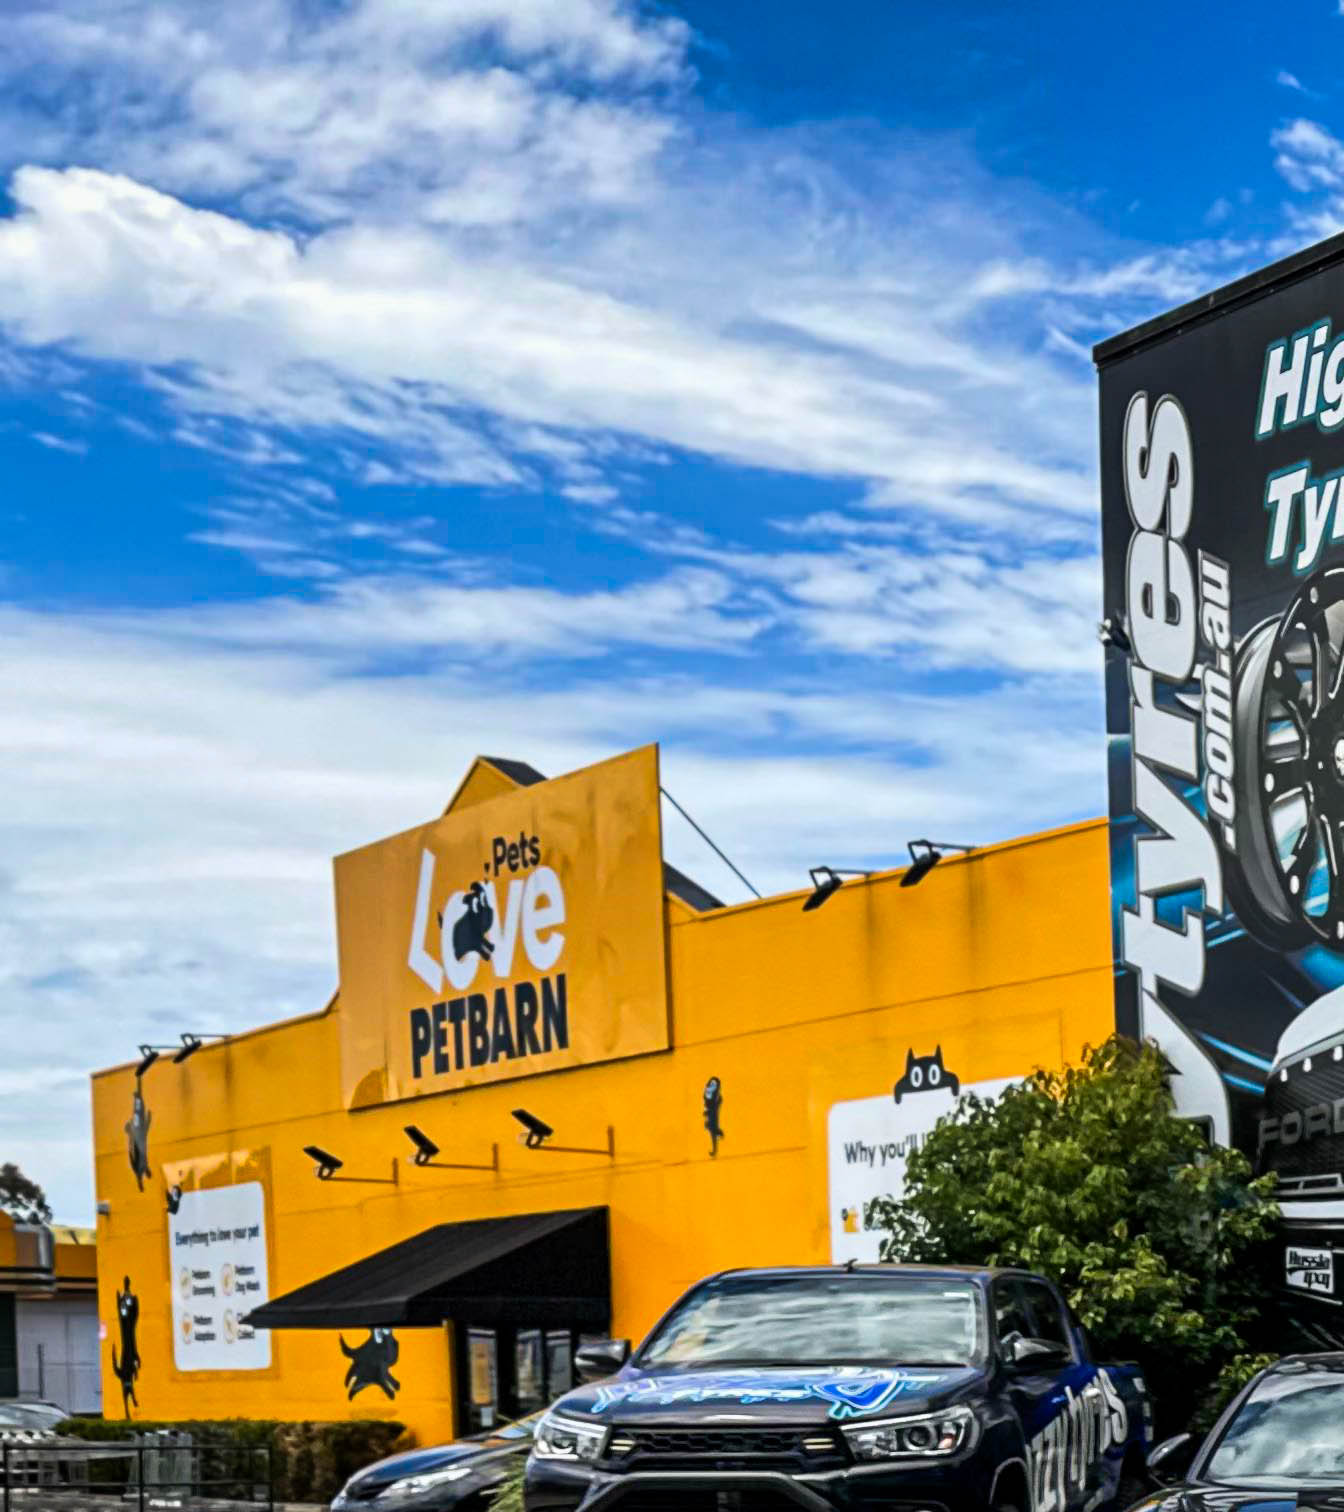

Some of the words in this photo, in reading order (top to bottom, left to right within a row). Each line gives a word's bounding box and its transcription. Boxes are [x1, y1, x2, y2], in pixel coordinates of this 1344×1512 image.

[492, 831, 541, 877] Pets
[408, 848, 567, 994] Love
[410, 972, 569, 1079] PETBARN
[844, 1140, 876, 1168] Why
